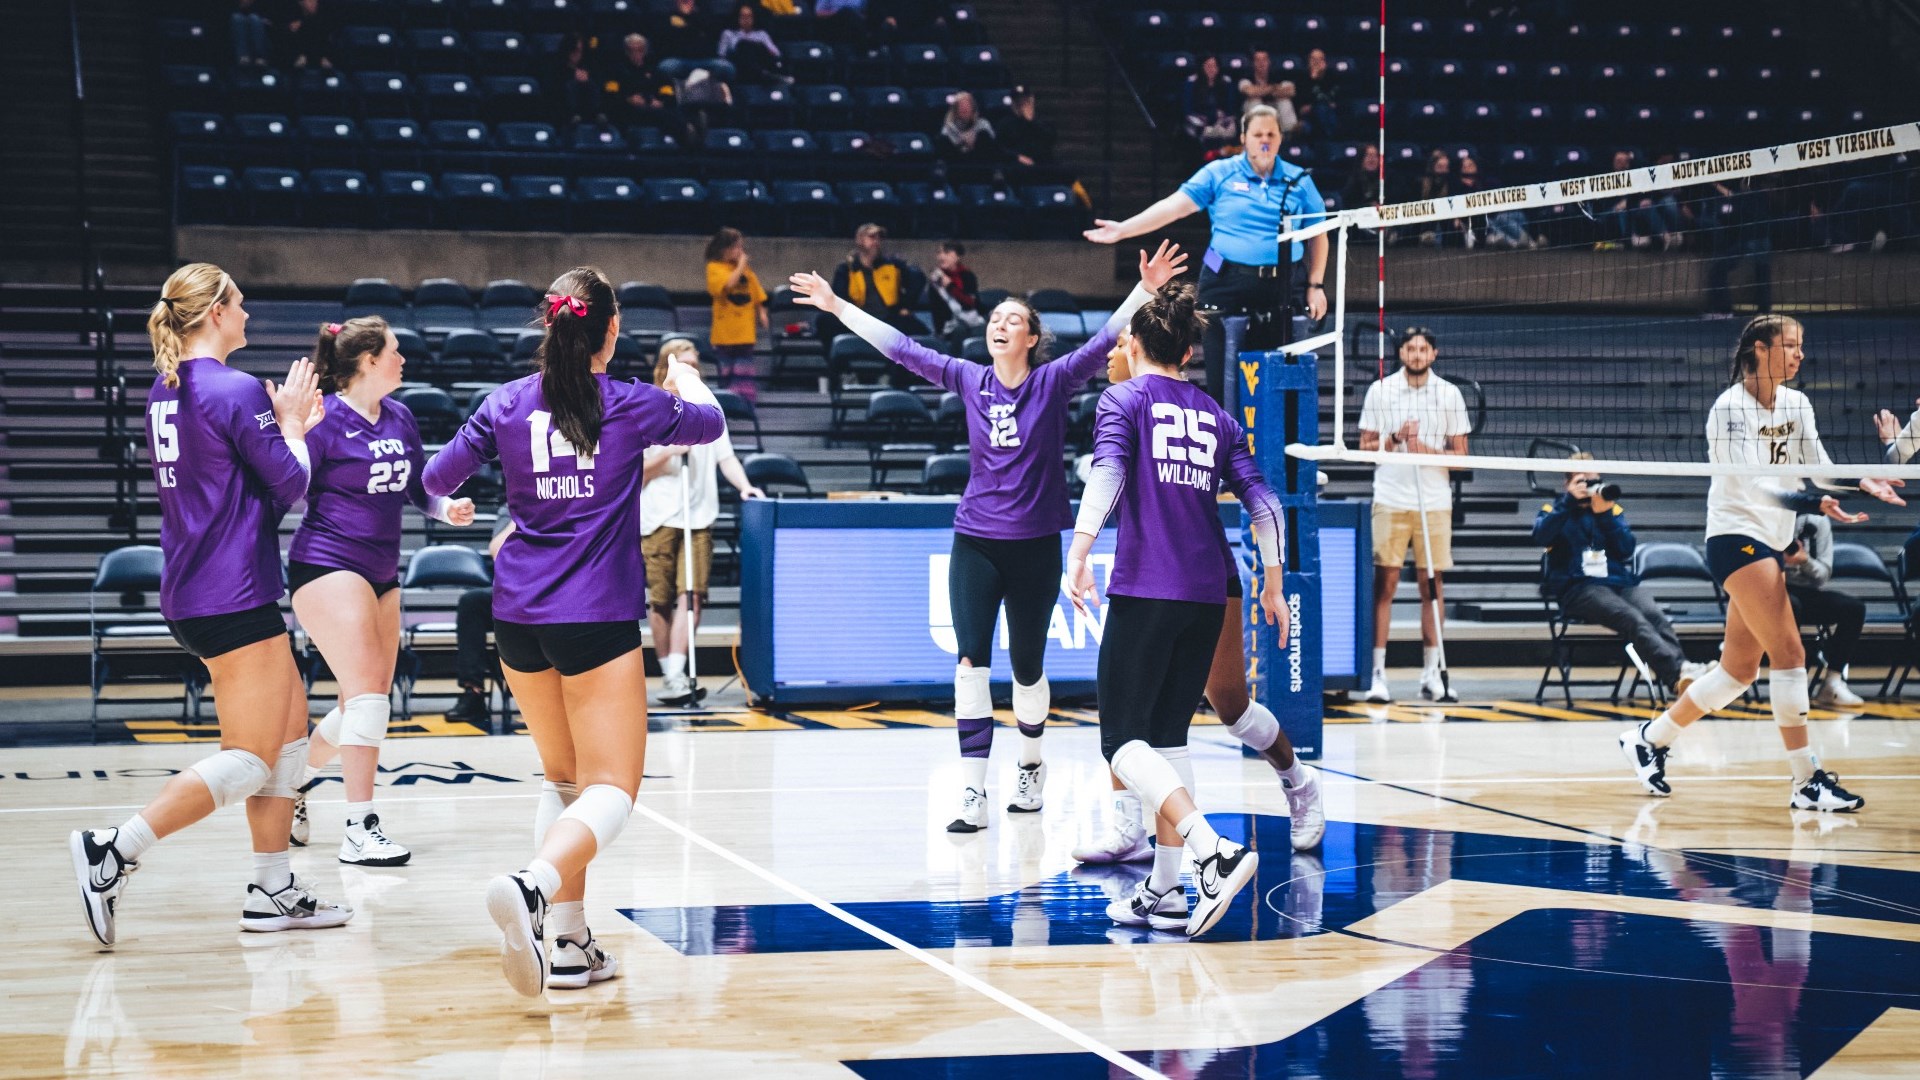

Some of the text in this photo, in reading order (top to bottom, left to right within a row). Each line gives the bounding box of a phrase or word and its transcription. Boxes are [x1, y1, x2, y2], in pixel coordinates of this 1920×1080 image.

[1402, 202, 1436, 218] VIRGINIA
[1465, 187, 1527, 208] MOUNTAINEERS
[1560, 180, 1585, 197] WEST
[1589, 172, 1632, 192] VIRGINIA
[1671, 152, 1752, 180] MOUNTAINEERS
[1797, 139, 1831, 161] WEST
[1835, 128, 1896, 154] VIRGINIA
[149, 400, 180, 462] 15
[525, 409, 600, 473] 14
[989, 416, 1021, 447] 12
[1151, 402, 1218, 469] 25
[1769, 441, 1788, 464] 16
[367, 459, 411, 494] 23
[536, 474, 595, 500] NICHOLS
[1287, 593, 1303, 692] sports imports
